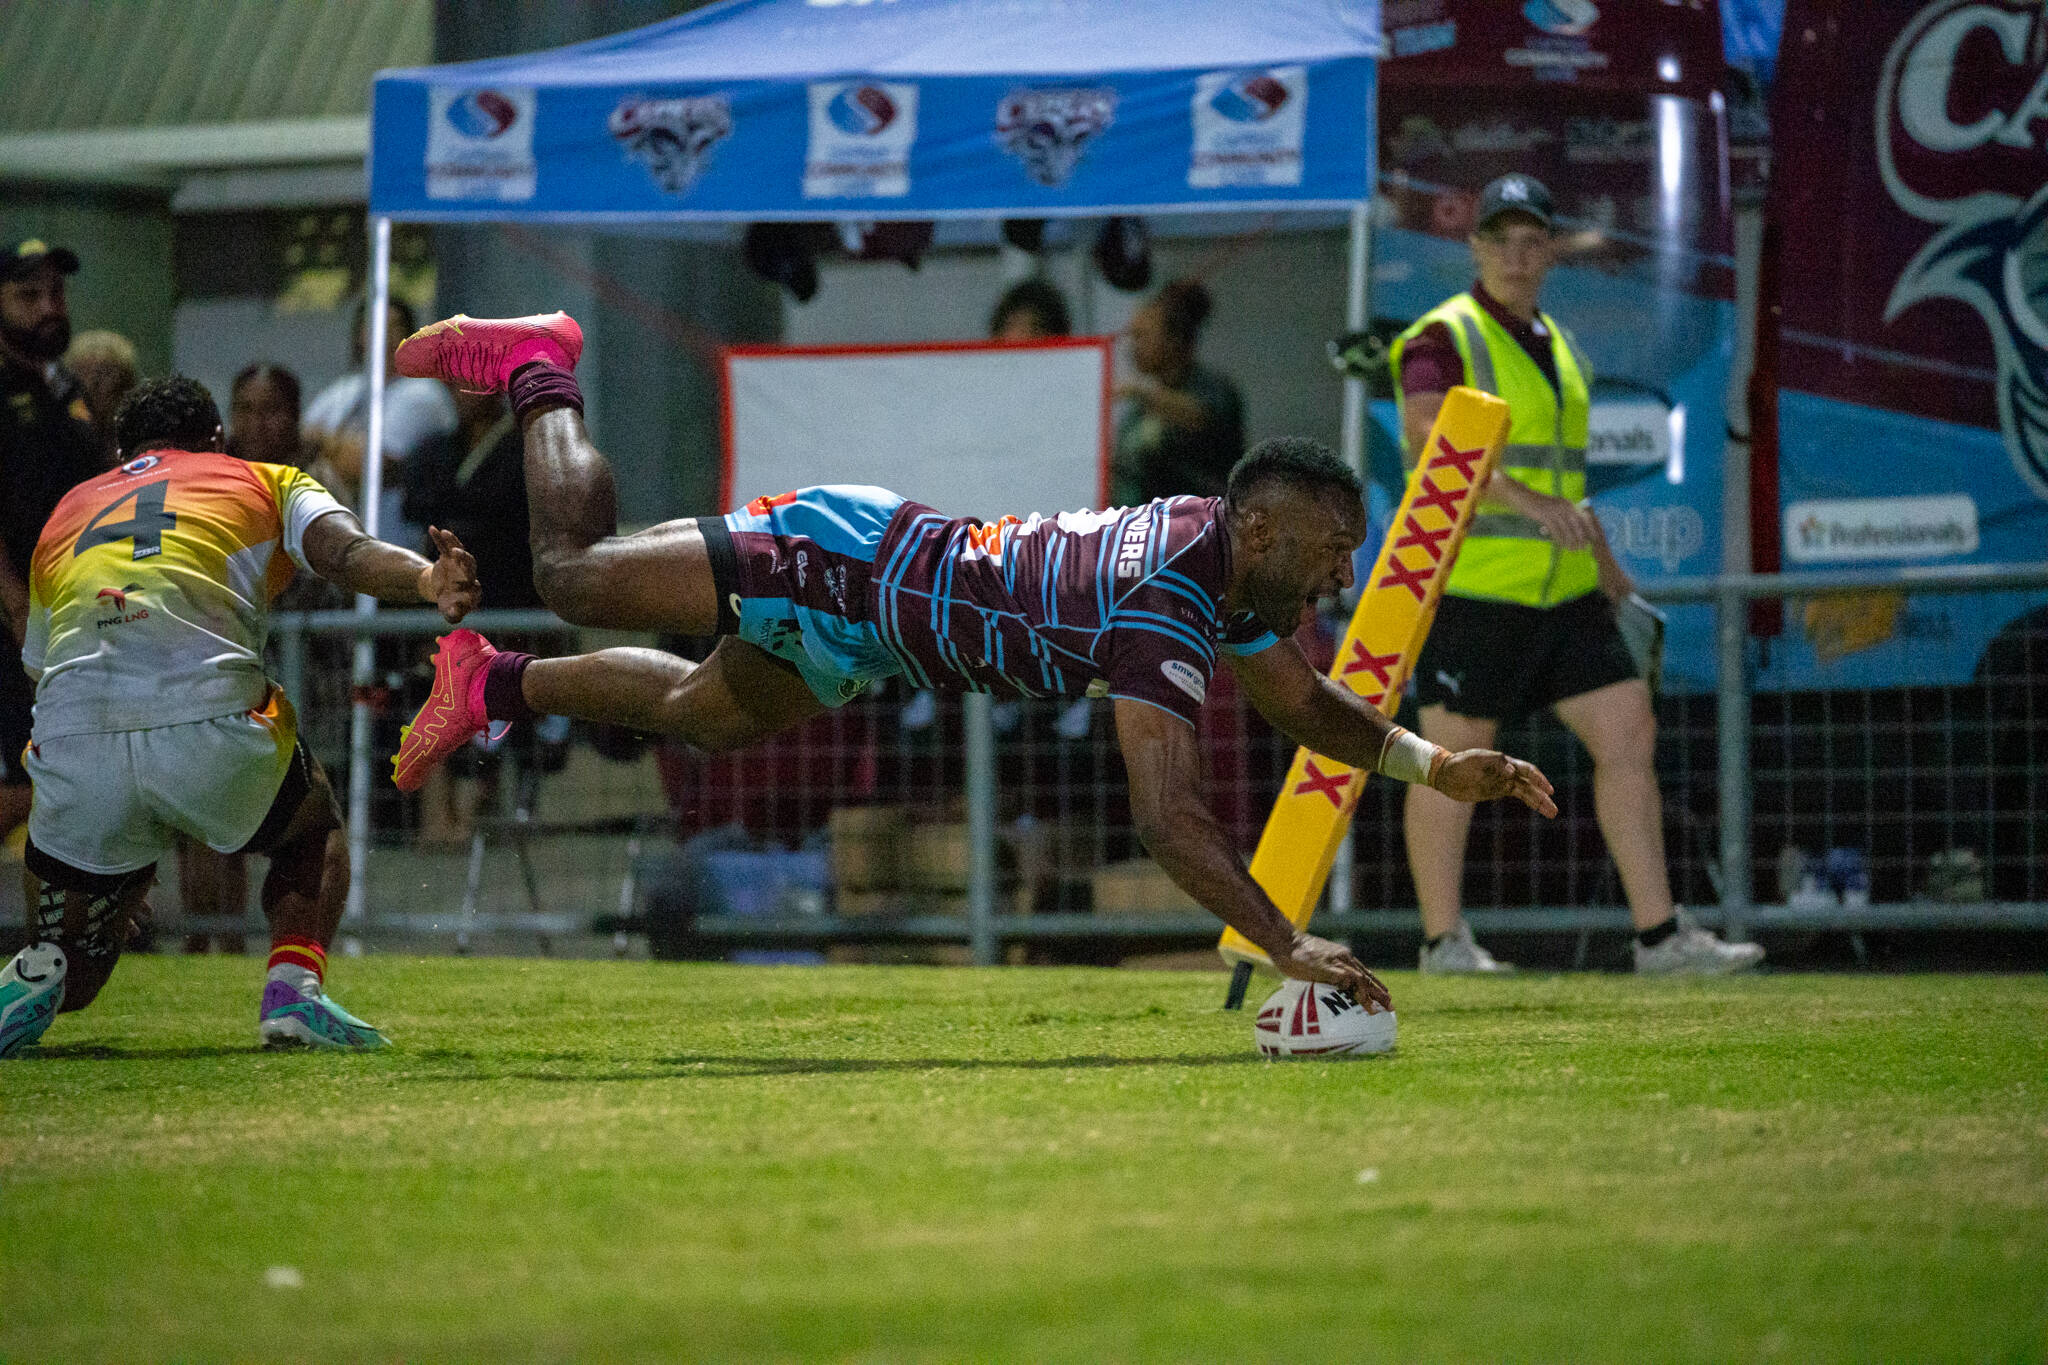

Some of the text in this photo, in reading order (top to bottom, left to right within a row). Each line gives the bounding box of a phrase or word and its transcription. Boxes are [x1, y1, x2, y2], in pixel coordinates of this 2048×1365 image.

[74, 479, 176, 559] 4
[1378, 434, 1486, 602] XXXX
[97, 609, 149, 629] PNG LNG
[1171, 662, 1194, 678] smw
